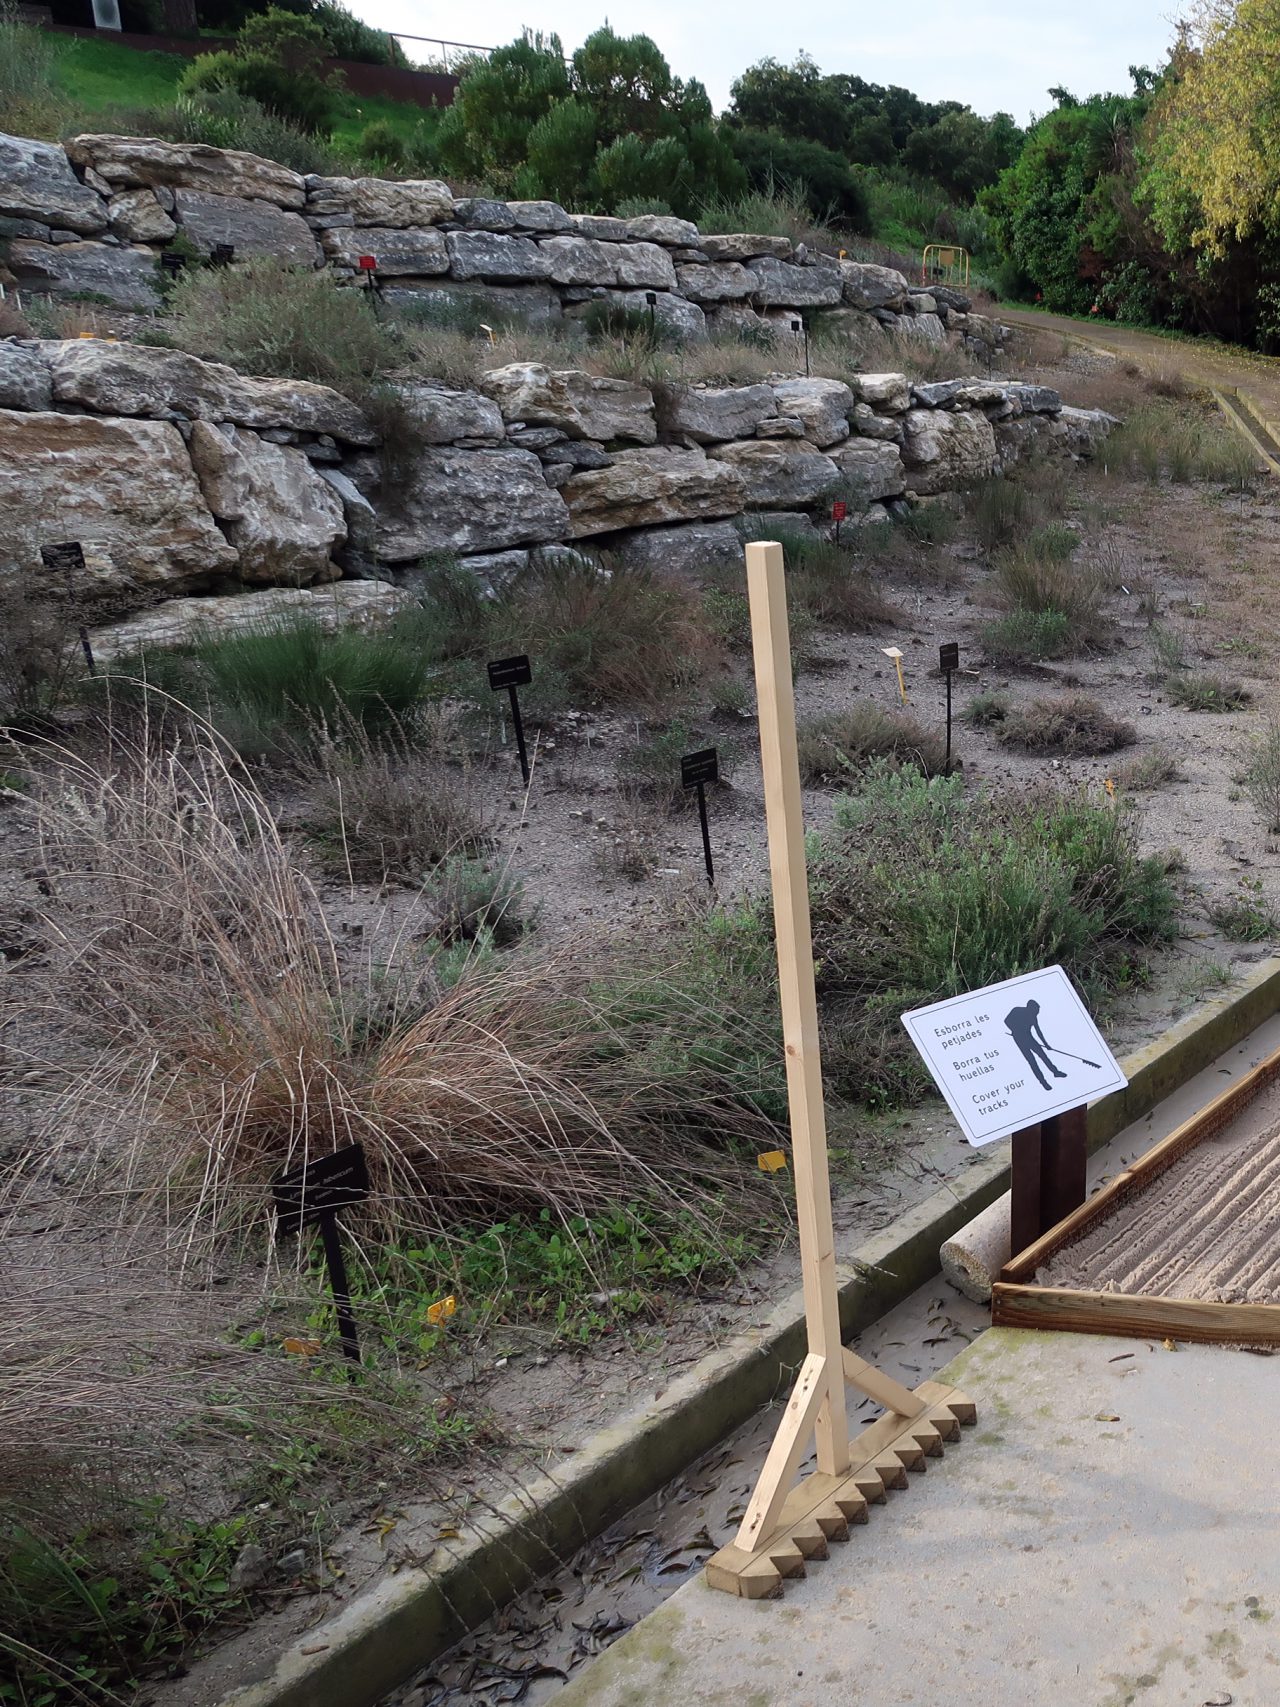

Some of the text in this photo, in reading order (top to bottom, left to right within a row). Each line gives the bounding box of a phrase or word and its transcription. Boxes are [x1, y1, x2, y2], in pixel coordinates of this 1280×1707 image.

[934, 1013, 990, 1037] Esborra les
[941, 1029, 982, 1050] petjades
[952, 1049, 1000, 1071] Borra tus
[959, 1064, 995, 1082] huellas
[972, 1079, 1025, 1104] Cover your
[978, 1099, 1009, 1116] tracks
